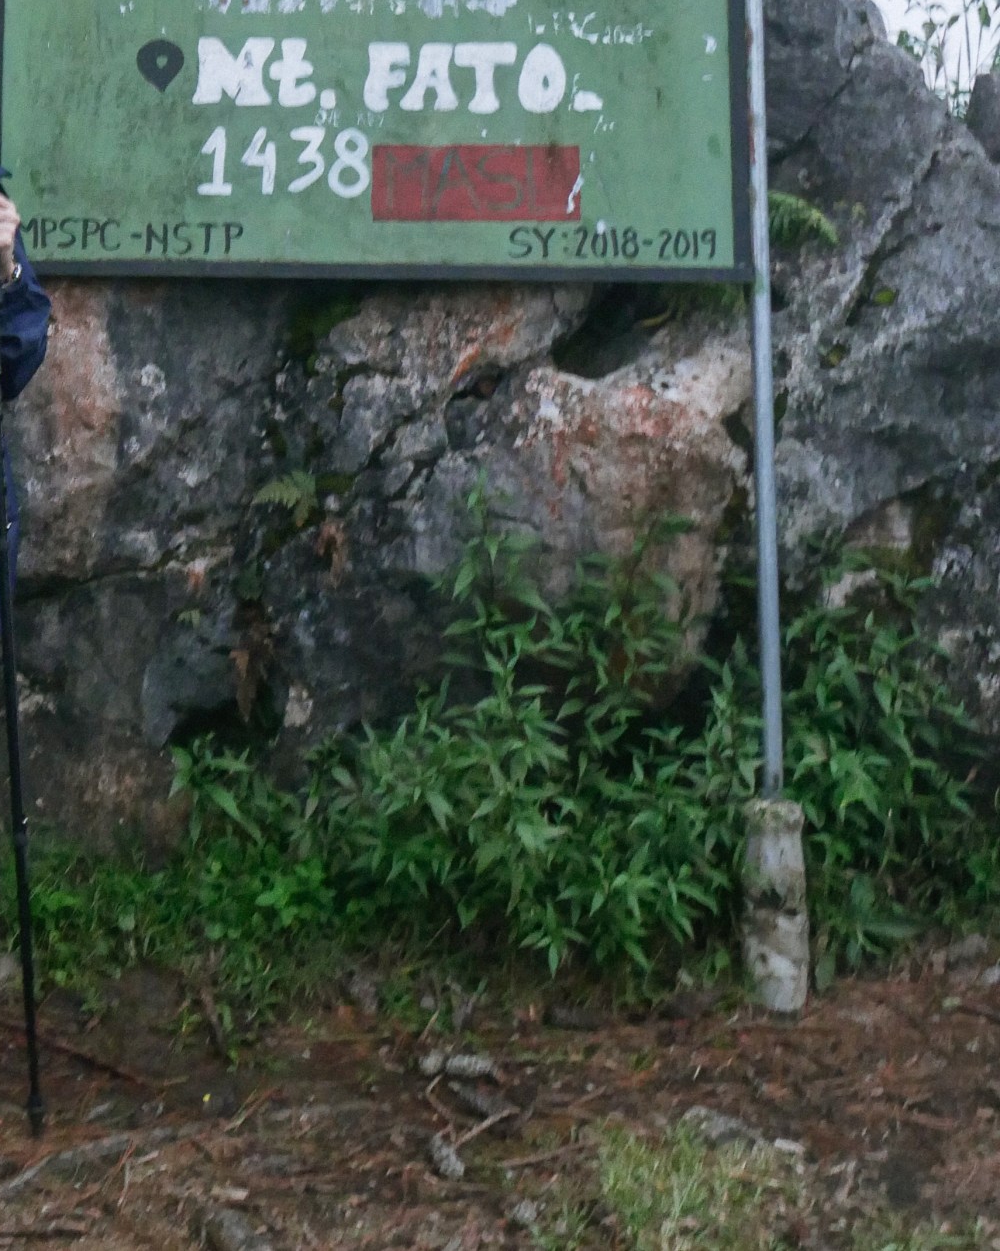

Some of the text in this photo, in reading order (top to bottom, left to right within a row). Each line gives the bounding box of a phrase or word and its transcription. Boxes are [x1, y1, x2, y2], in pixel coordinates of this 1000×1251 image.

[192, 36, 567, 114] Mt. FATO
[197, 126, 556, 215] 1438 MASL
